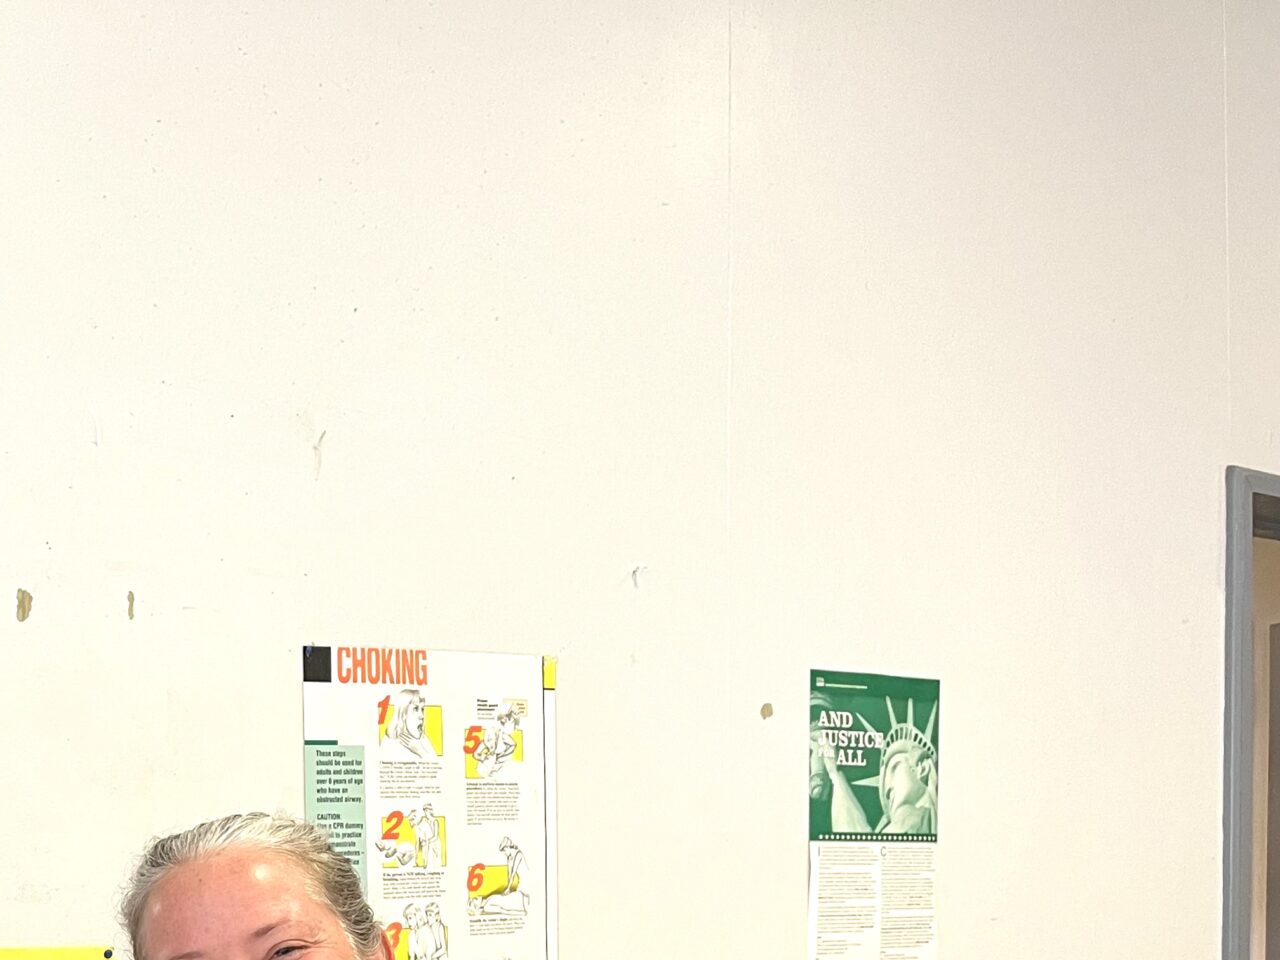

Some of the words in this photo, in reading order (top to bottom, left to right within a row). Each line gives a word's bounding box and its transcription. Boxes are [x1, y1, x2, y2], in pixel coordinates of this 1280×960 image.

[337, 647, 428, 685] CHOKING
[378, 695, 390, 724] 1
[818, 711, 853, 728] AND
[463, 726, 482, 754] 5
[818, 730, 884, 748] JUSTICE
[837, 749, 866, 766] ALL
[381, 811, 403, 839] 2
[467, 863, 485, 891] 6
[386, 922, 402, 949] 3
